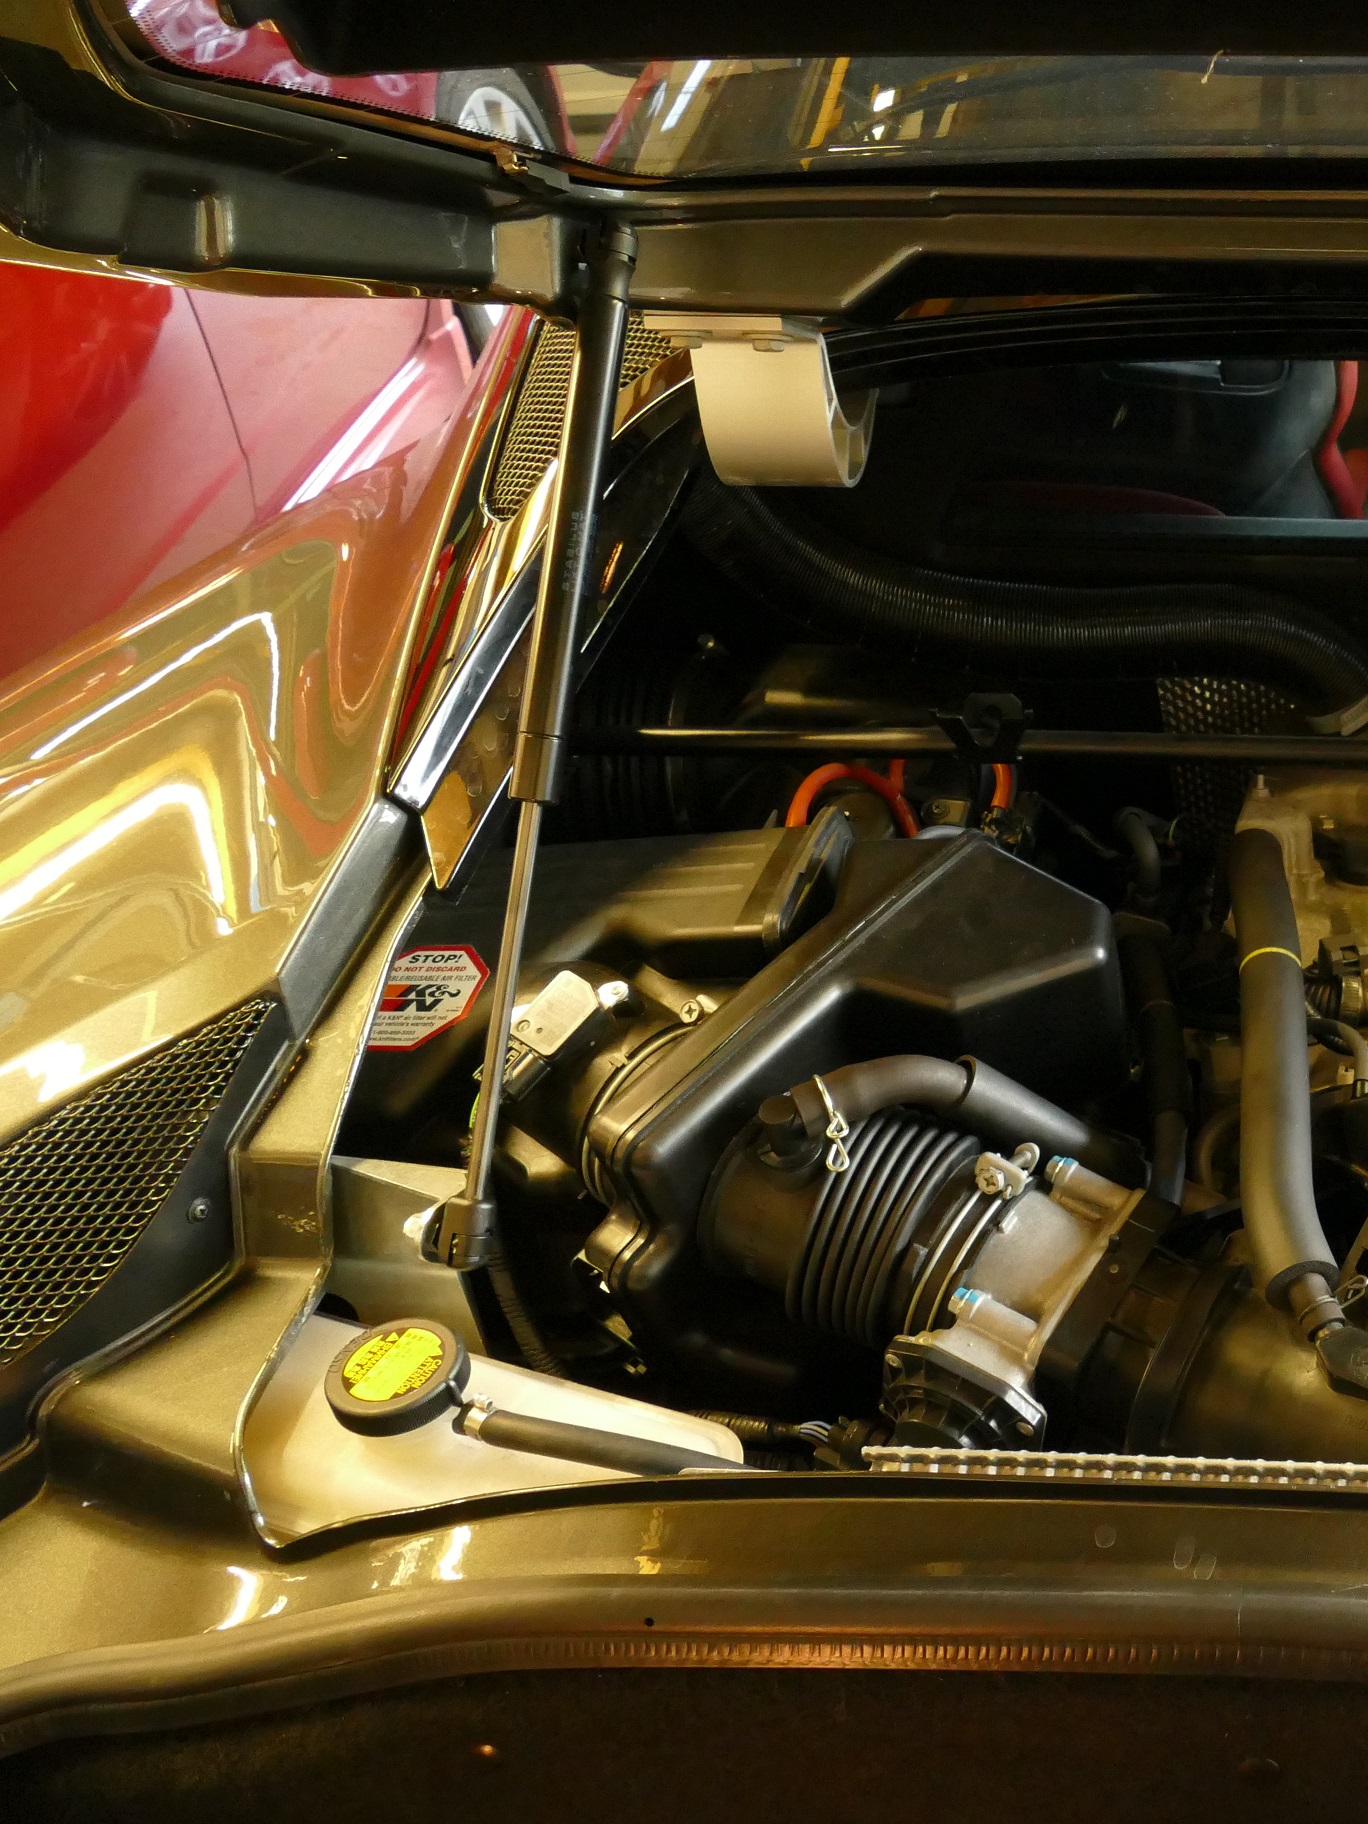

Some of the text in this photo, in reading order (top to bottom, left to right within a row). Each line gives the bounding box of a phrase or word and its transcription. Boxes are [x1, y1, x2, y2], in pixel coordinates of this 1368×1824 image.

[562, 511, 579, 591] STABILUS
[409, 954, 463, 963] STOP!
[396, 1356, 431, 1394] ATTENTION
[411, 1359, 442, 1388] CAUTION
